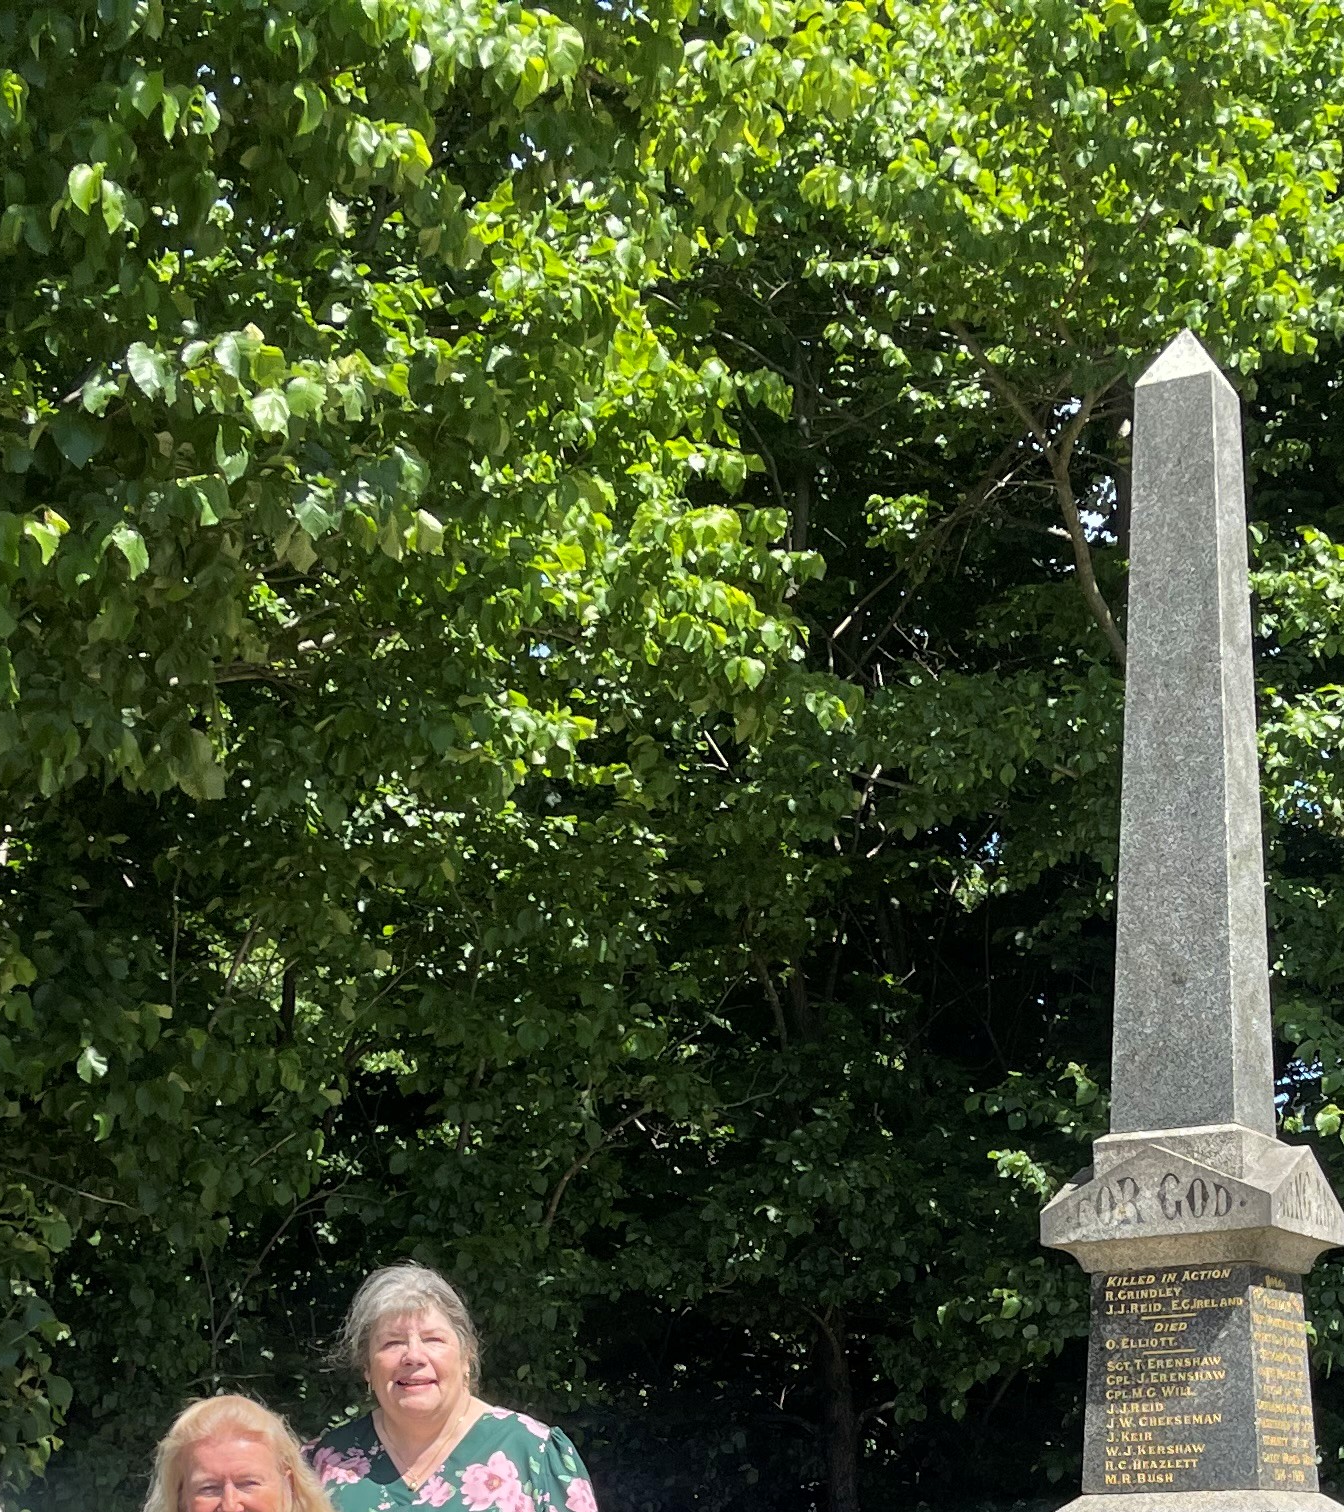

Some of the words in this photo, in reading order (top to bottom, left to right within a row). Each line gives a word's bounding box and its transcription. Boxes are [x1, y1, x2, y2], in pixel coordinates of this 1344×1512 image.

[1106, 1275, 1156, 1288] KILLED
[1161, 1272, 1177, 1284] IN
[1182, 1268, 1232, 1282] ACTION
[1154, 1322, 1188, 1333] DIED
